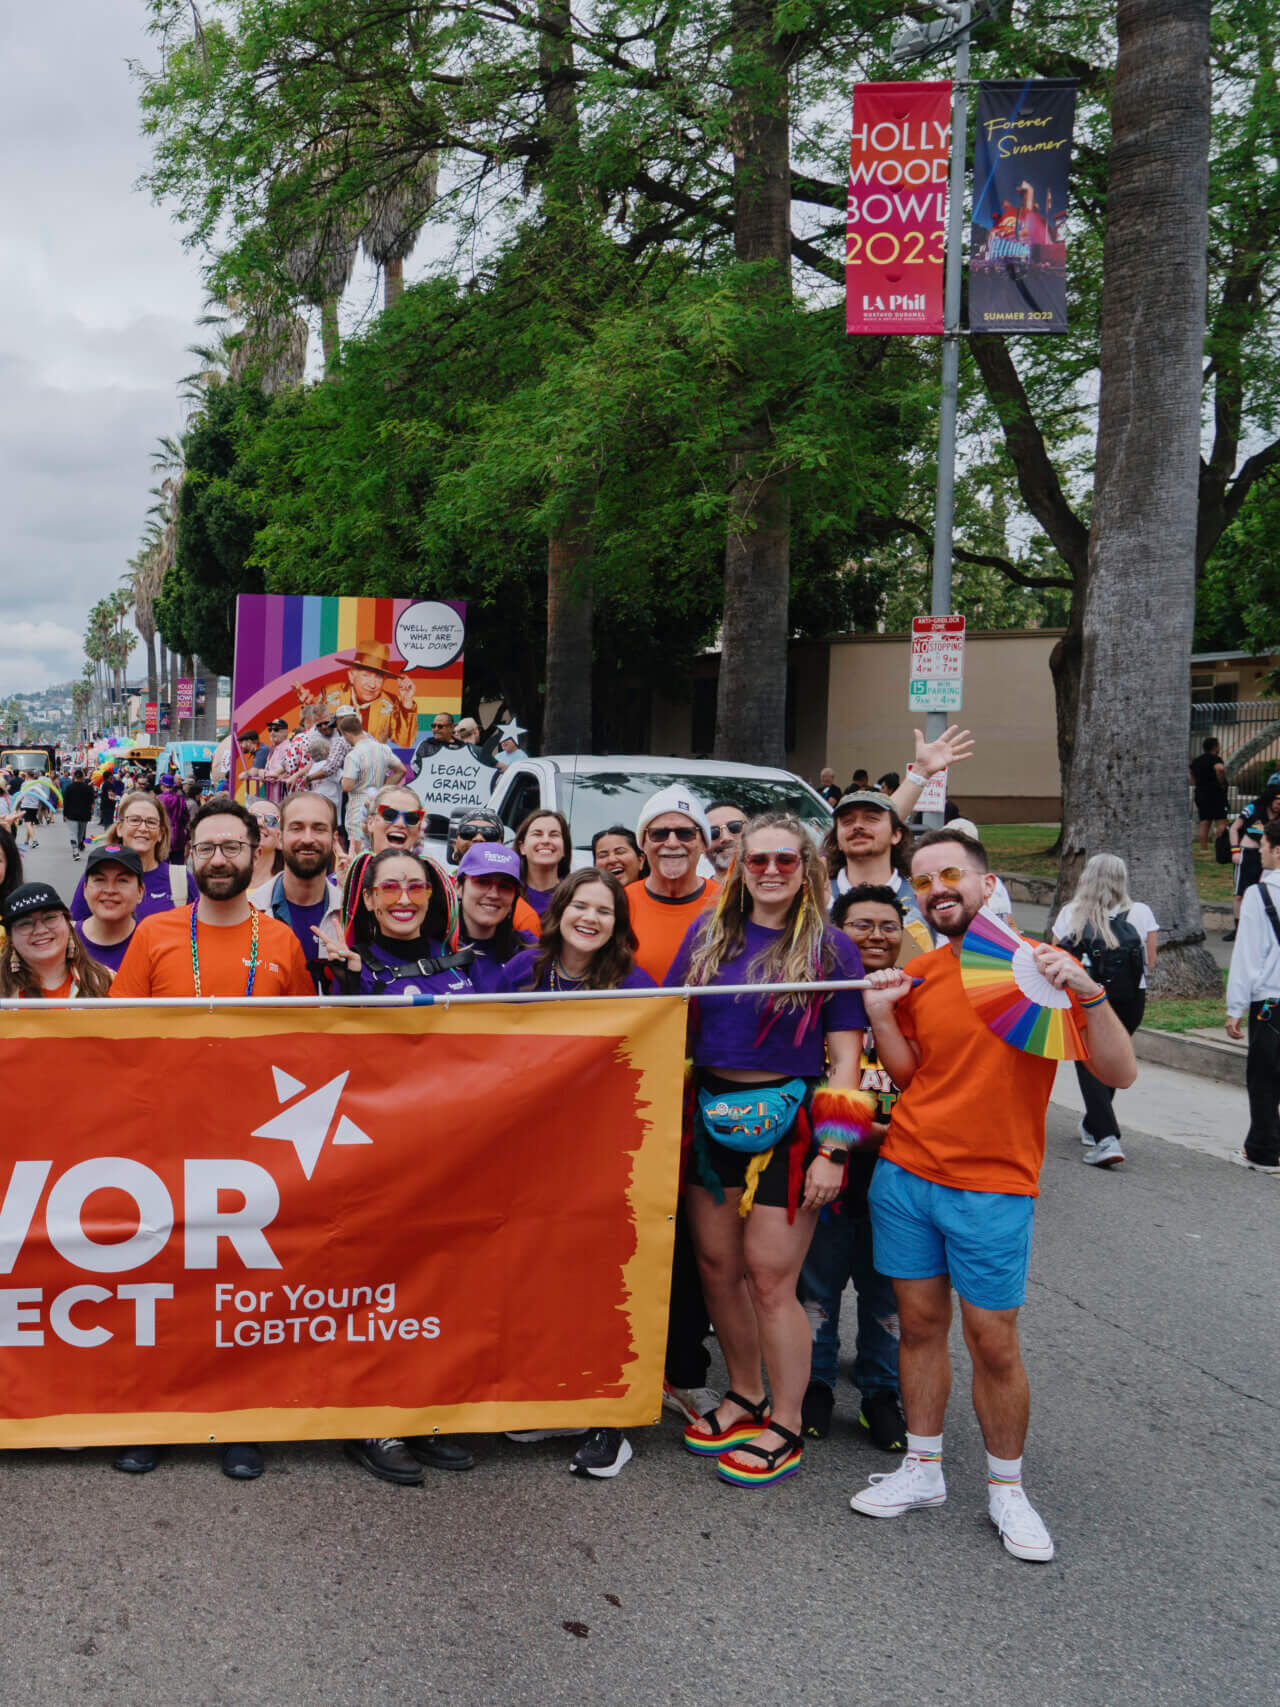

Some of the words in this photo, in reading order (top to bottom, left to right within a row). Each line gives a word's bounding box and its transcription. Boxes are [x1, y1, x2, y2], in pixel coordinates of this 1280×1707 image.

[984, 116, 1053, 142] Forever
[998, 135, 1067, 158] Summer
[849, 159, 949, 186] WOOD
[863, 295, 886, 310] LA
[889, 294, 926, 310] Phil
[983, 312, 1025, 321] SUMMER
[1027, 311, 1053, 320] 2023
[409, 633, 432, 641] WHAT
[435, 633, 452, 641] ARE
[913, 641, 928, 653] NO
[929, 641, 963, 651] STOPPING
[912, 681, 926, 694] 15
[430, 764, 481, 777] LEGACY
[432, 778, 477, 791] GRAND
[424, 792, 483, 806] MARSHAL
[215, 1283, 274, 1313] For
[281, 1283, 396, 1314] Young
[215, 1315, 337, 1348] LGBTQ
[346, 1312, 441, 1342] Lives
